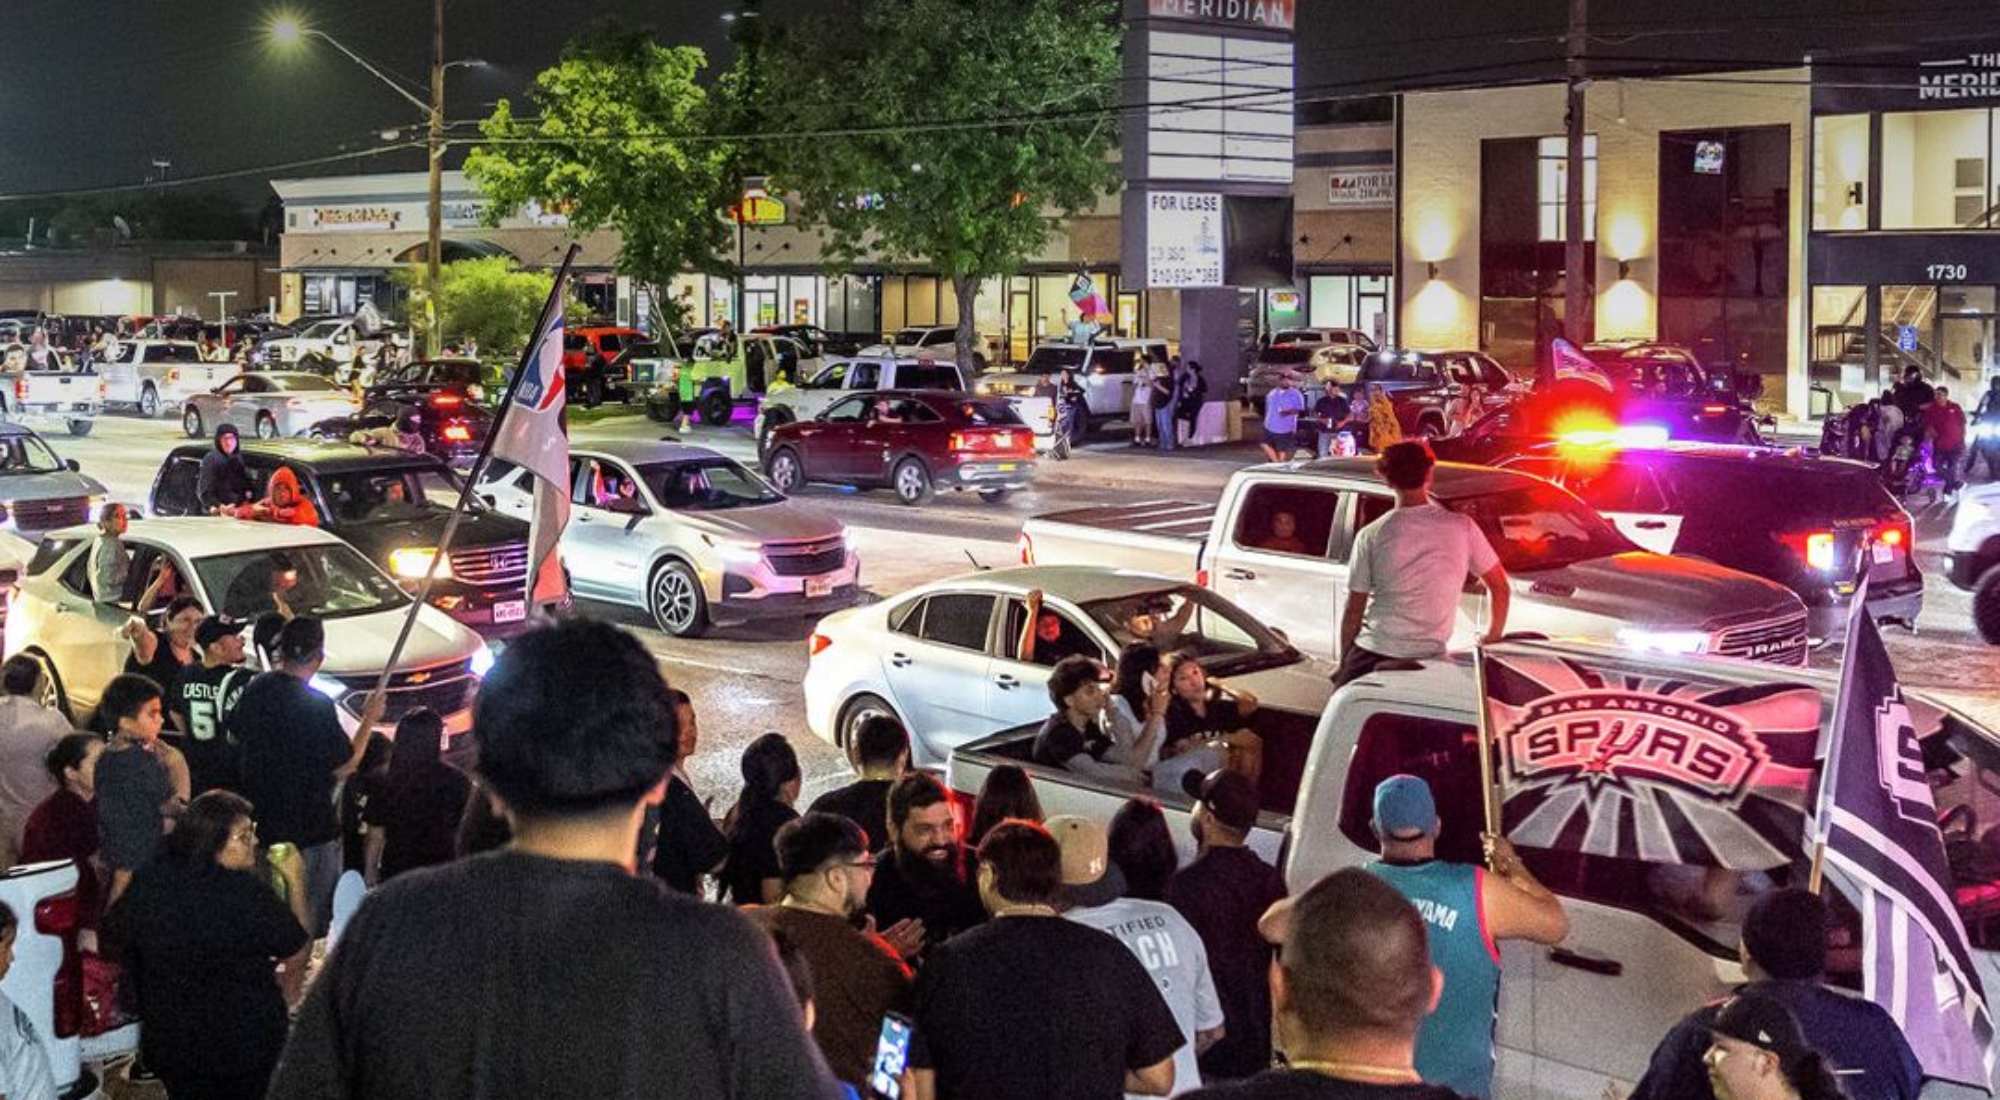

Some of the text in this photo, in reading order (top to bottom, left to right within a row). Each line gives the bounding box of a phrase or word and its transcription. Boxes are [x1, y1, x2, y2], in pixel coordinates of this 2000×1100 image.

[1161, 0, 1286, 24] MERIDIAN
[1357, 175, 1379, 188] FOR
[1152, 195, 1217, 211] FOR LEASE
[1926, 264, 1967, 280] 1730
[1755, 638, 1794, 656] RAM
[190, 700, 215, 740] 5
[1541, 698, 1730, 733] SAN ANTONIO
[1528, 718, 1731, 780] SPURS
